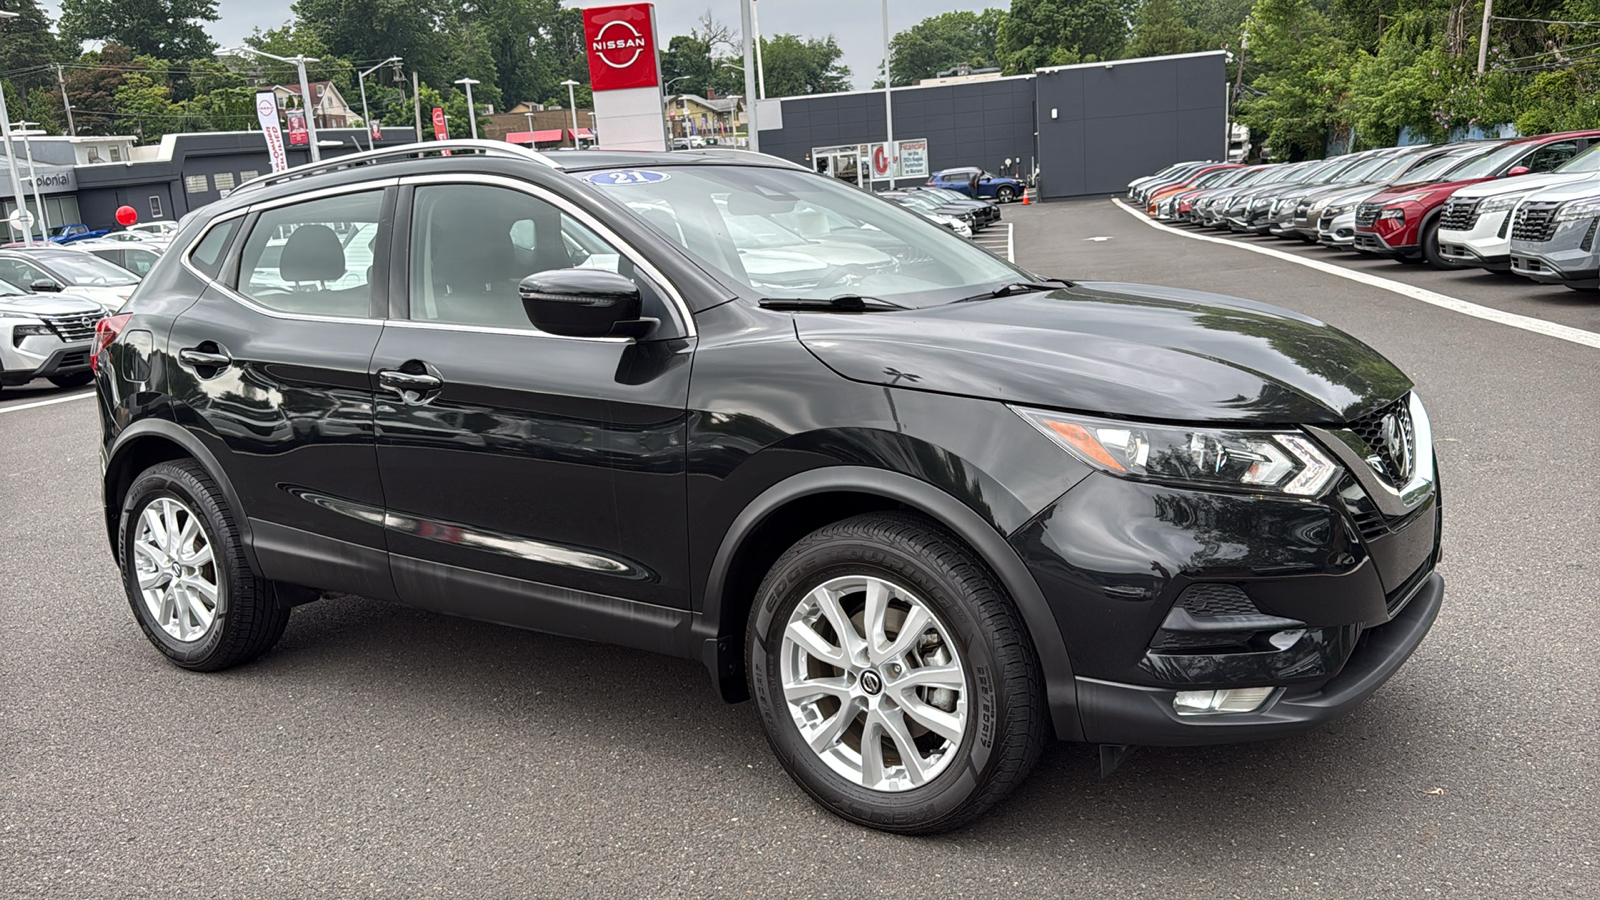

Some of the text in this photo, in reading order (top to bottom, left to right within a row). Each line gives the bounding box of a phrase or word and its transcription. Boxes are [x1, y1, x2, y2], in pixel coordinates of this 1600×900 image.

[593, 38, 645, 50] NISSAN
[609, 171, 650, 184] 21
[765, 556, 818, 613] EDGE
[829, 550, 951, 610] TOURING
